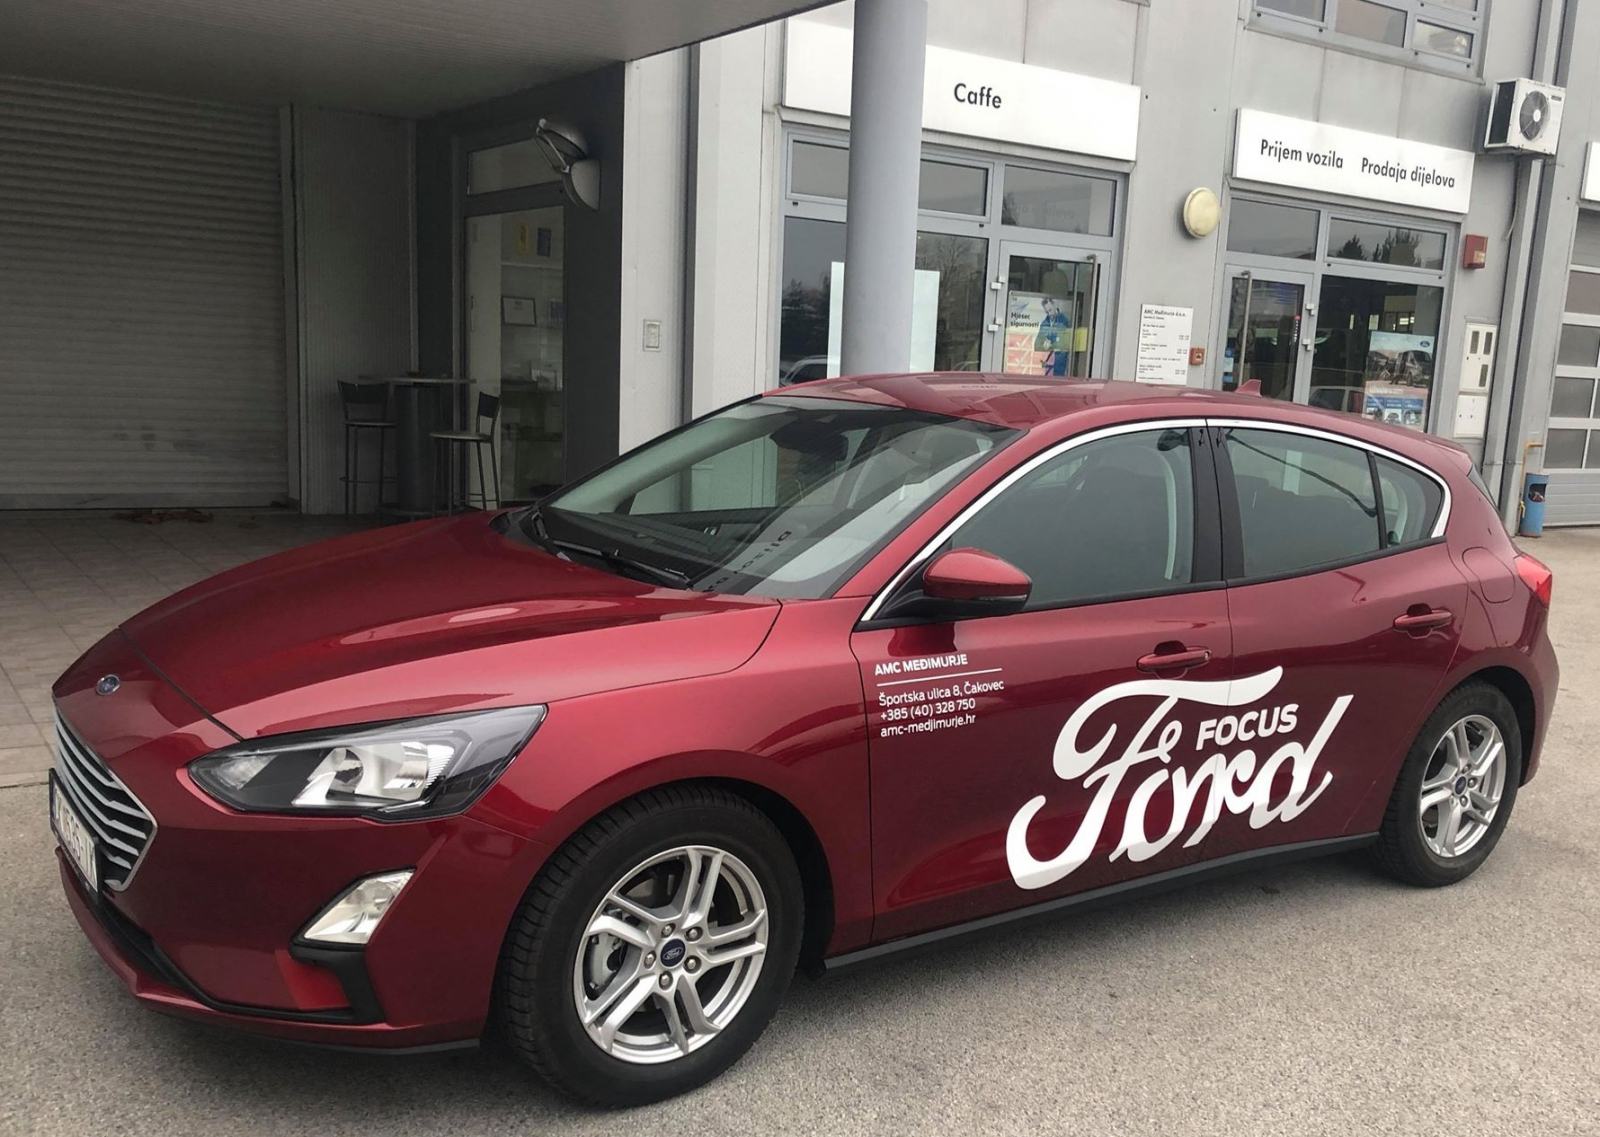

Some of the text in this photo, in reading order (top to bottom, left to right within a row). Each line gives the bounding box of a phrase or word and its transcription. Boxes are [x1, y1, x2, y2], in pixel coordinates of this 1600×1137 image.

[954, 83, 1002, 109] Caffe
[1260, 138, 1344, 169] Prijem vozila
[1361, 157, 1456, 188] Prodaja dijelova
[874, 654, 968, 676] AMC MEĐIMURJE
[927, 687, 951, 700] ulica
[952, 685, 963, 697] 8,
[963, 680, 1005, 695] Čakovec
[880, 697, 976, 722] +385 (40) 328 750
[880, 714, 976, 737] amc-medjimurje.hr
[1196, 703, 1299, 751] FOCUS
[1005, 665, 1355, 890] Ford
